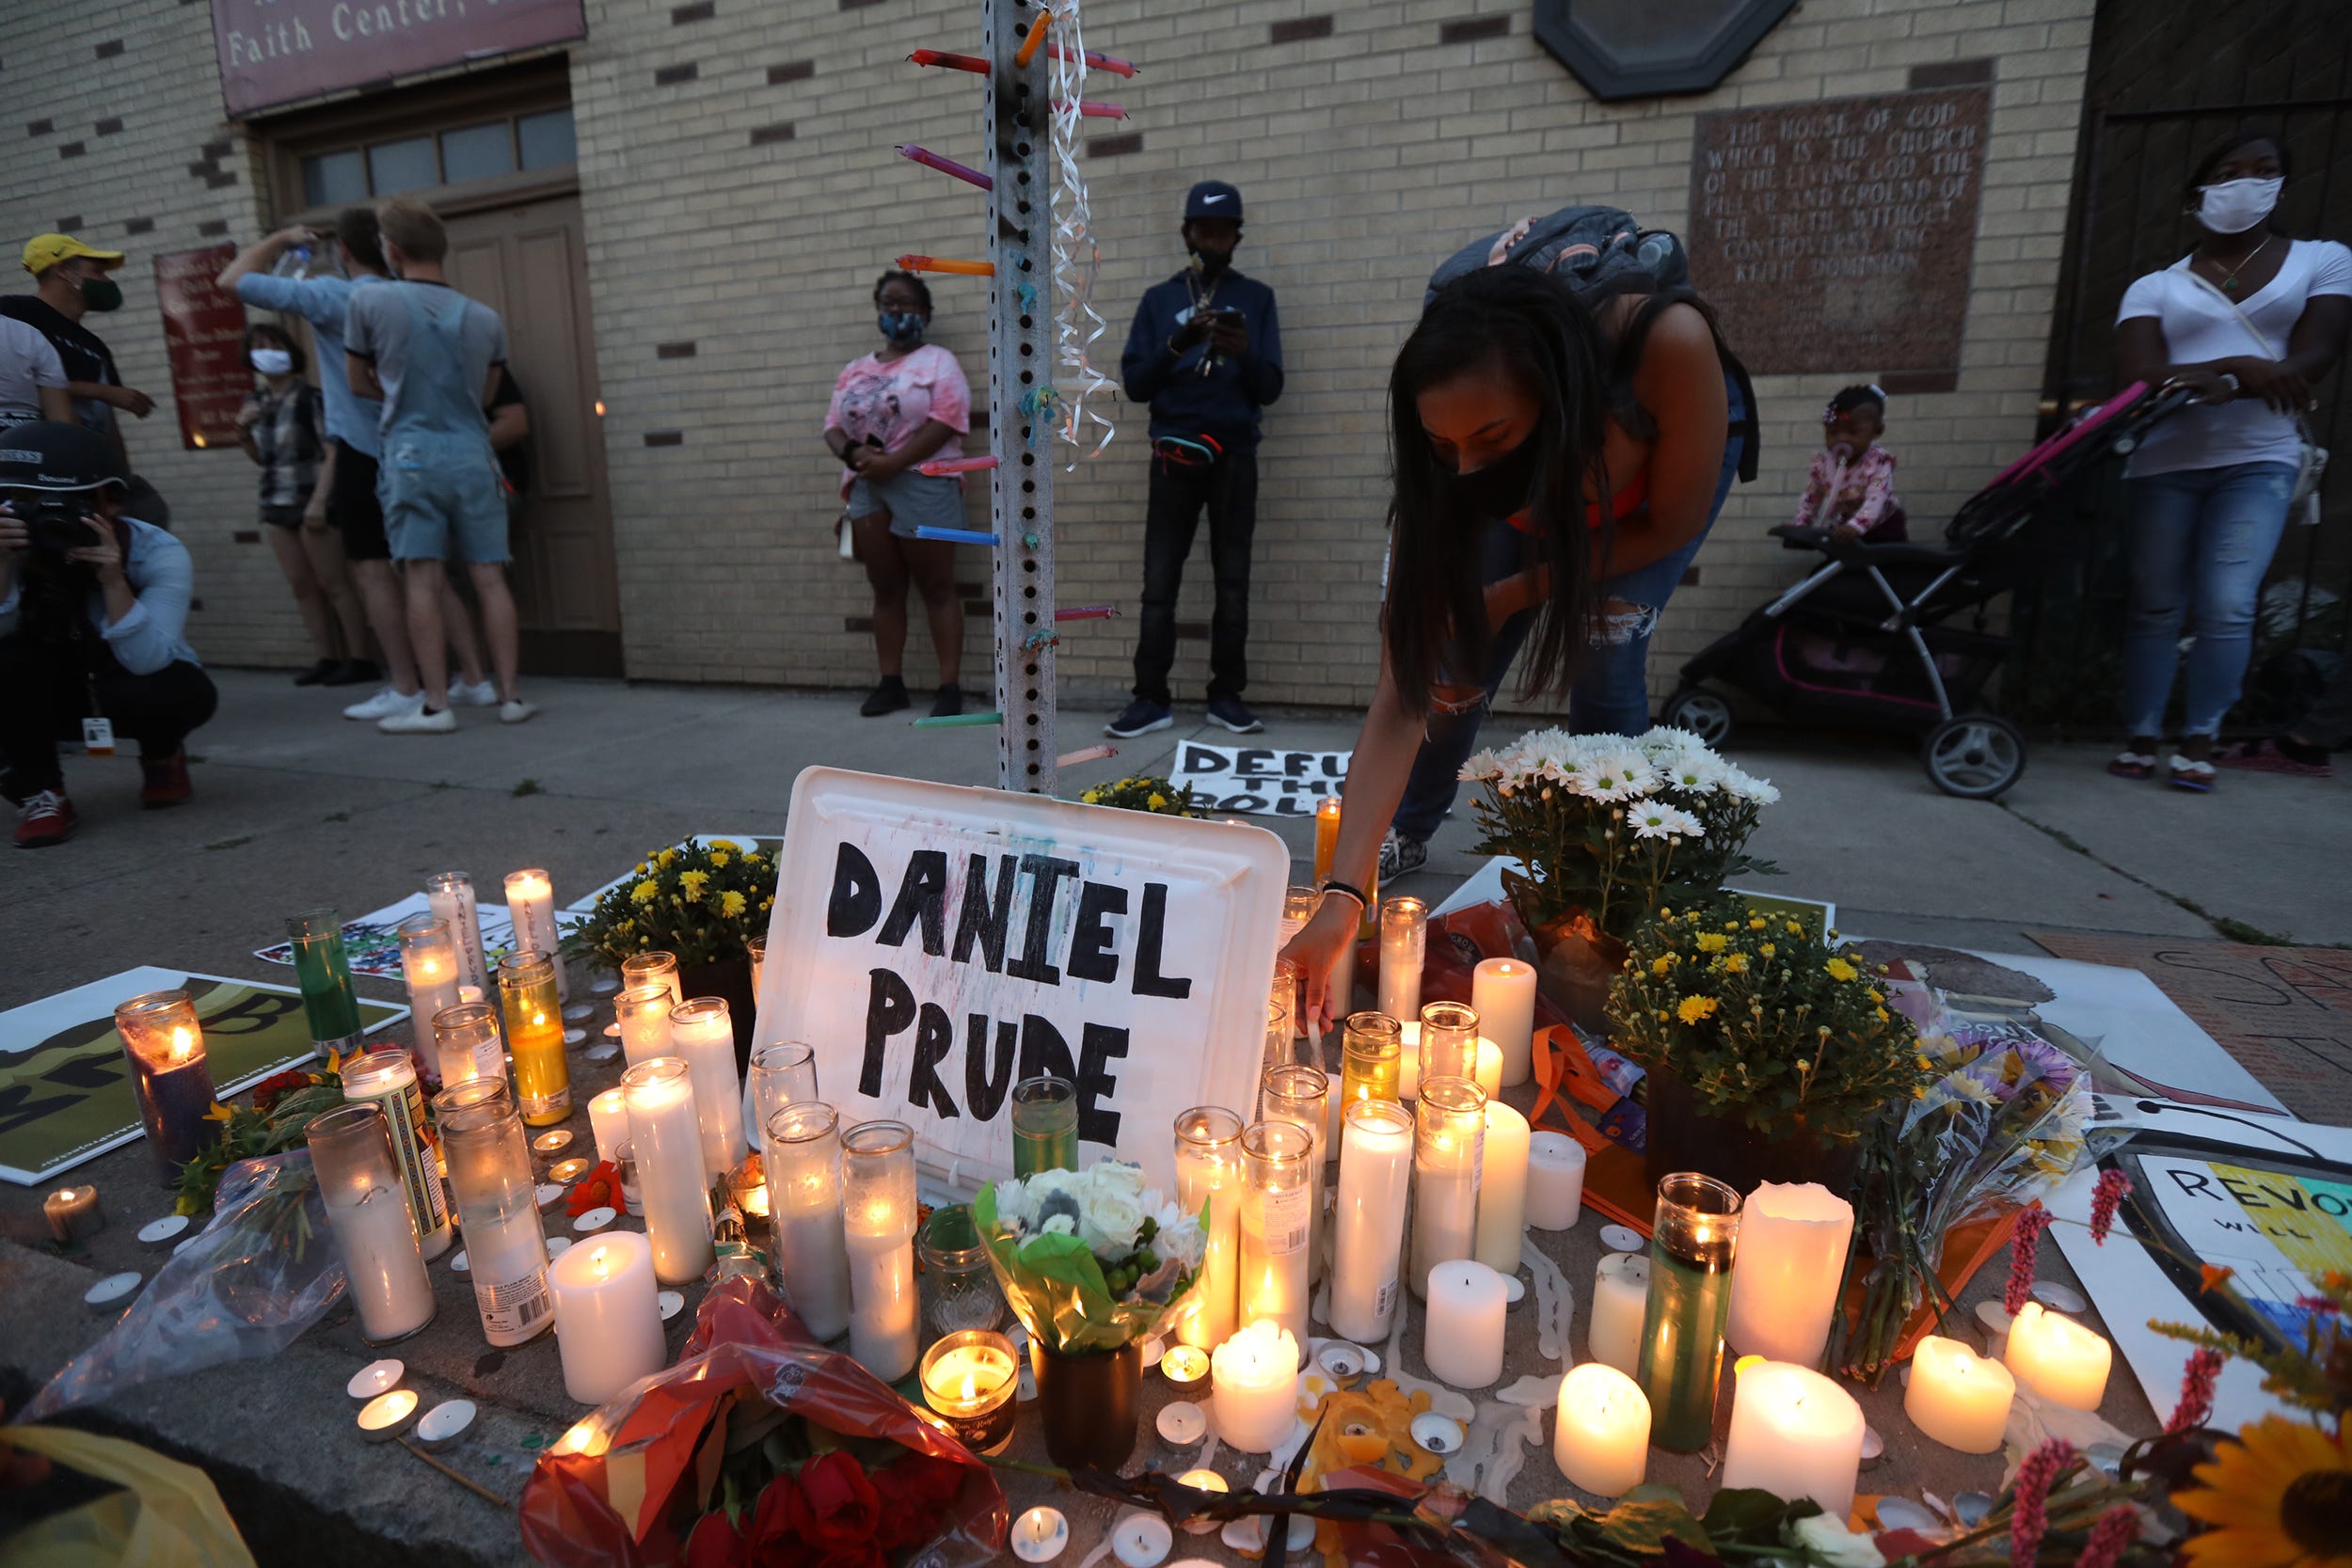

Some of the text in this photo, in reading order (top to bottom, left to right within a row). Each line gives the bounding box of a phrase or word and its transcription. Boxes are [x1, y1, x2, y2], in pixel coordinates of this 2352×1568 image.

[227, 16, 313, 68] Faith
[1706, 125, 1976, 169] WHICH IS THE CHURCH
[1727, 120, 1762, 145] THE
[1779, 112, 1848, 140] HOUSE
[1863, 107, 1892, 133] OF
[1703, 171, 1726, 194] OF
[1740, 168, 1777, 190] THE
[1785, 161, 1861, 186] LIVING
[1931, 150, 1973, 174] THE
[1704, 175, 1968, 216] PILLAR AND GROUND OF
[1714, 216, 1747, 238] THE
[1852, 200, 1952, 229] WITHOUT
[828, 842, 1192, 999] DANIEL
[858, 968, 1129, 1148] PRUDE
[2166, 1169, 2352, 1217] REVO
[2214, 1218, 2312, 1240] WILL
